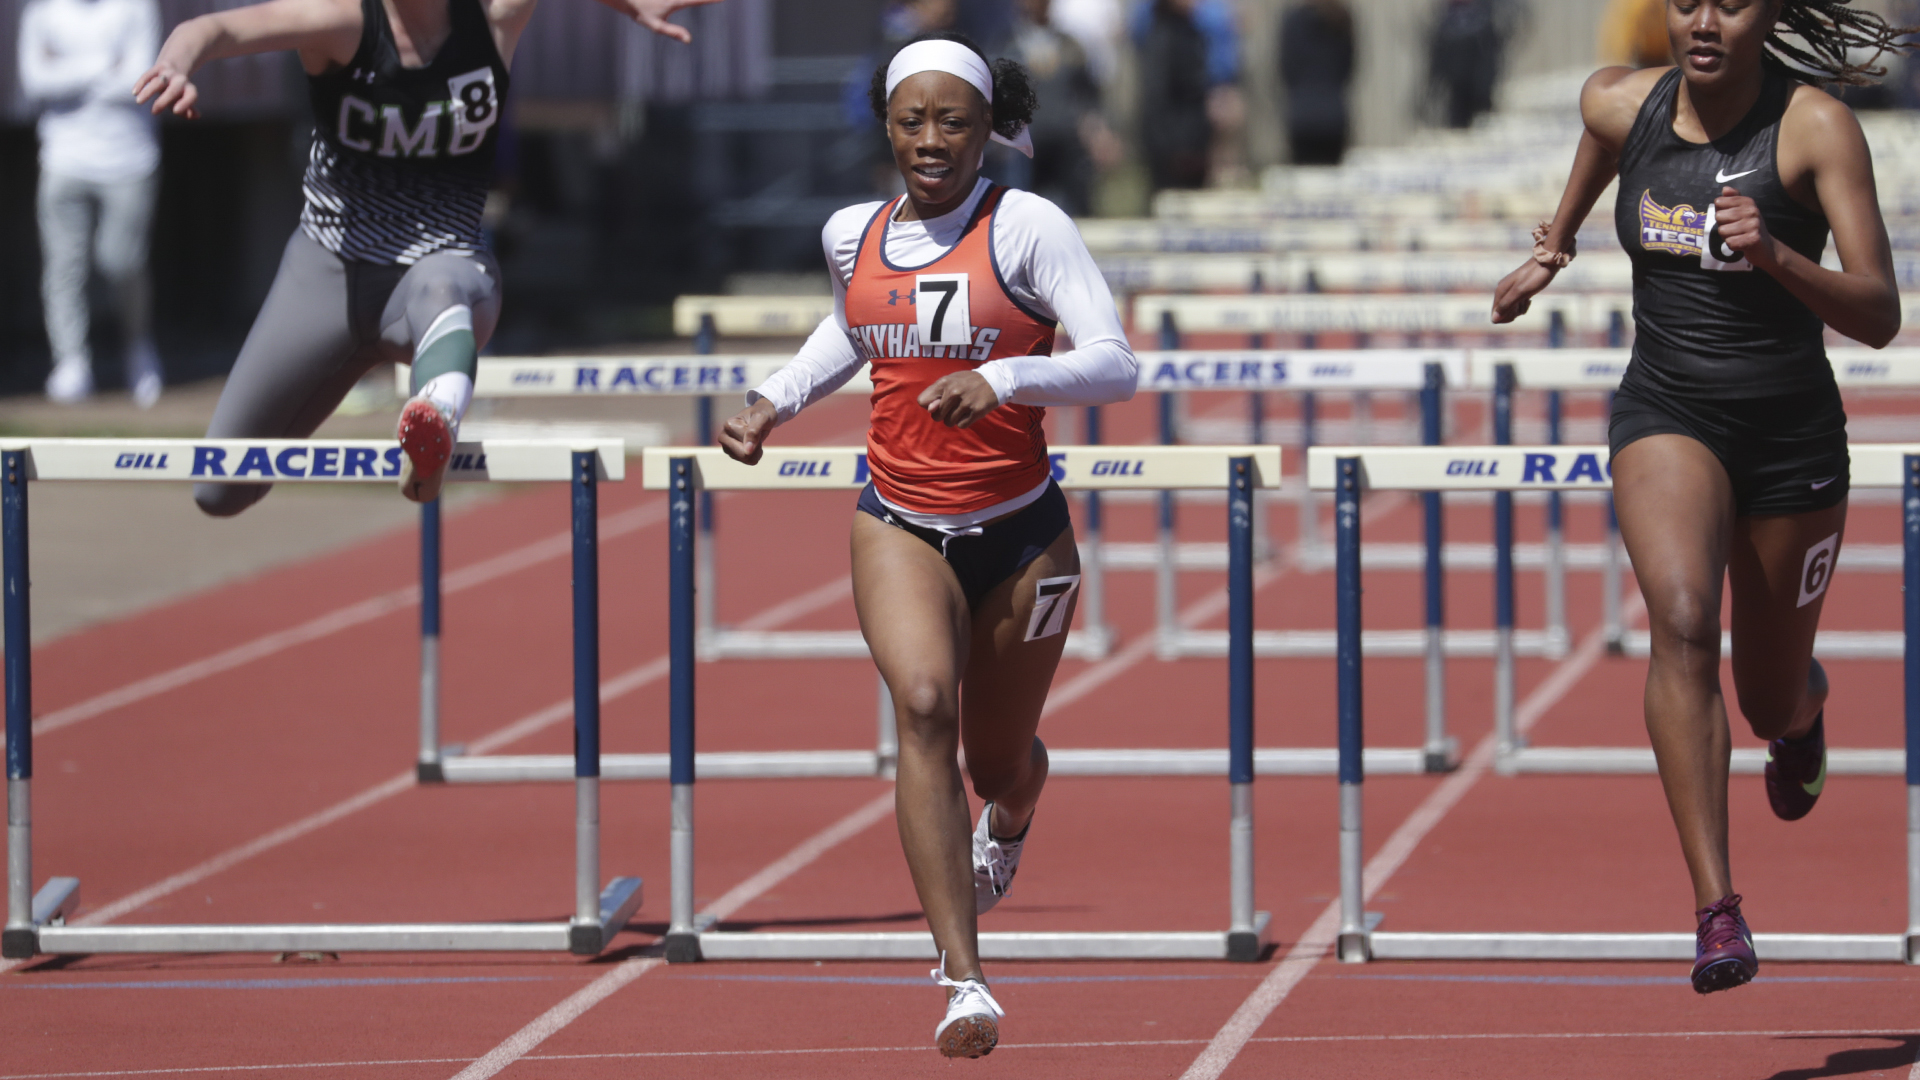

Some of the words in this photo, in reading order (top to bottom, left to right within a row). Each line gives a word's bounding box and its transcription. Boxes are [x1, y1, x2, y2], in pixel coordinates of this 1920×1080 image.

[461, 80, 491, 123] 8
[919, 280, 958, 342] 7
[574, 365, 749, 388] RACERS
[1134, 361, 1285, 383] ACERS
[115, 453, 168, 468] GILL
[191, 446, 403, 477] RACERS
[778, 460, 831, 476] GILL
[1091, 460, 1144, 475] GILL
[1446, 460, 1499, 476] GILL
[1805, 548, 1829, 595] 6
[1033, 582, 1072, 637] 7
